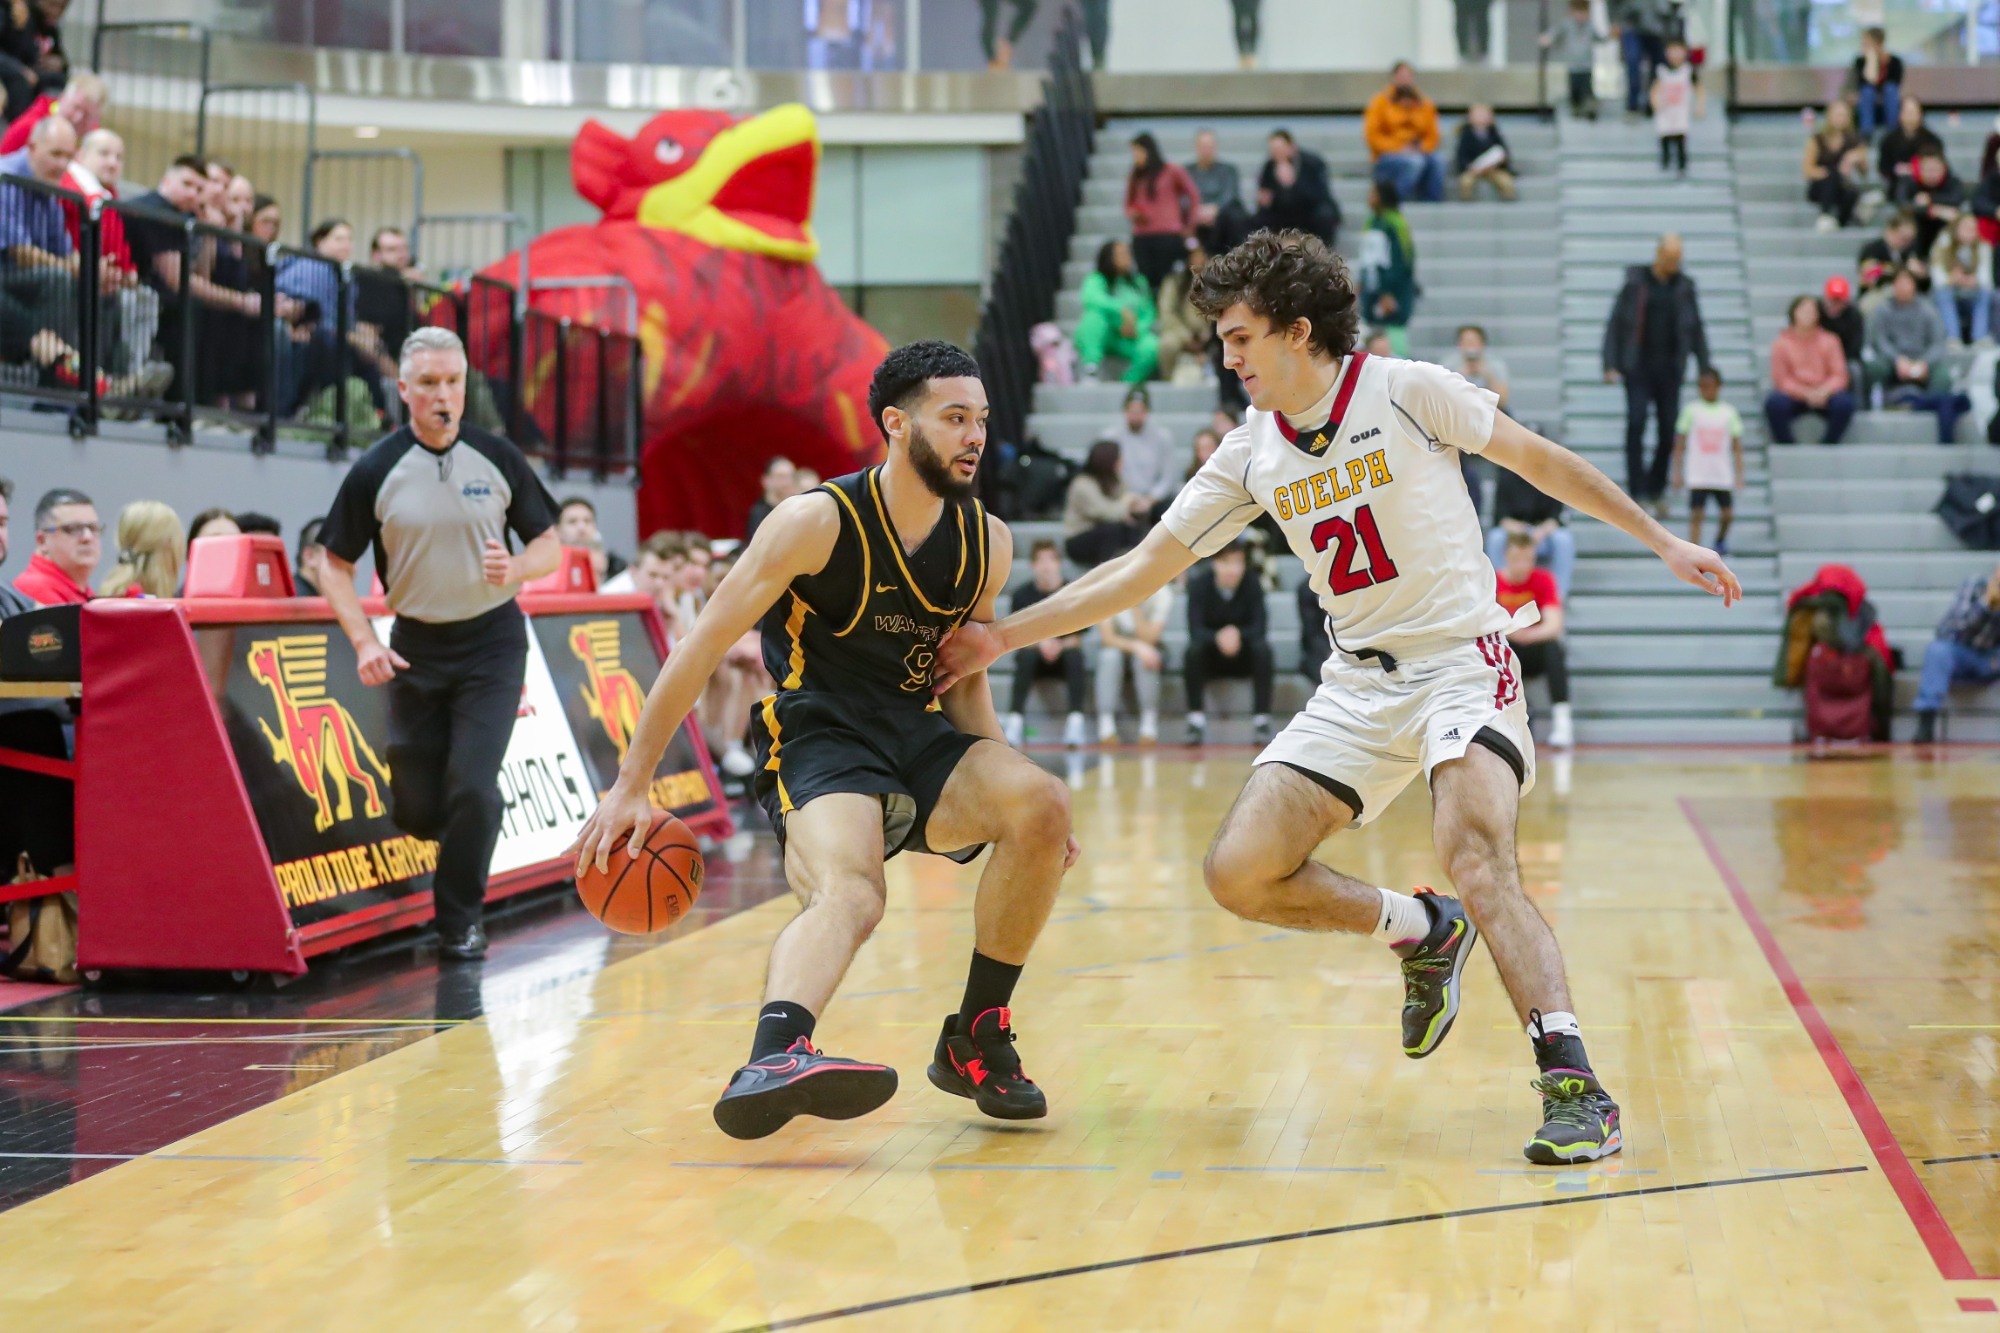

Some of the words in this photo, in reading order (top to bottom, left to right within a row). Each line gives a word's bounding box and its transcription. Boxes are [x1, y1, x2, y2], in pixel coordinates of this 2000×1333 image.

[1350, 427, 1382, 444] OUA
[1273, 449, 1394, 521] GUELPH
[1310, 504, 1400, 596] 21
[500, 752, 586, 839] PHONS
[273, 854, 339, 909] PROUD
[327, 849, 359, 895] TO
[347, 844, 379, 890] BE
[370, 842, 392, 885] A
[380, 834, 442, 882] GRYPH
